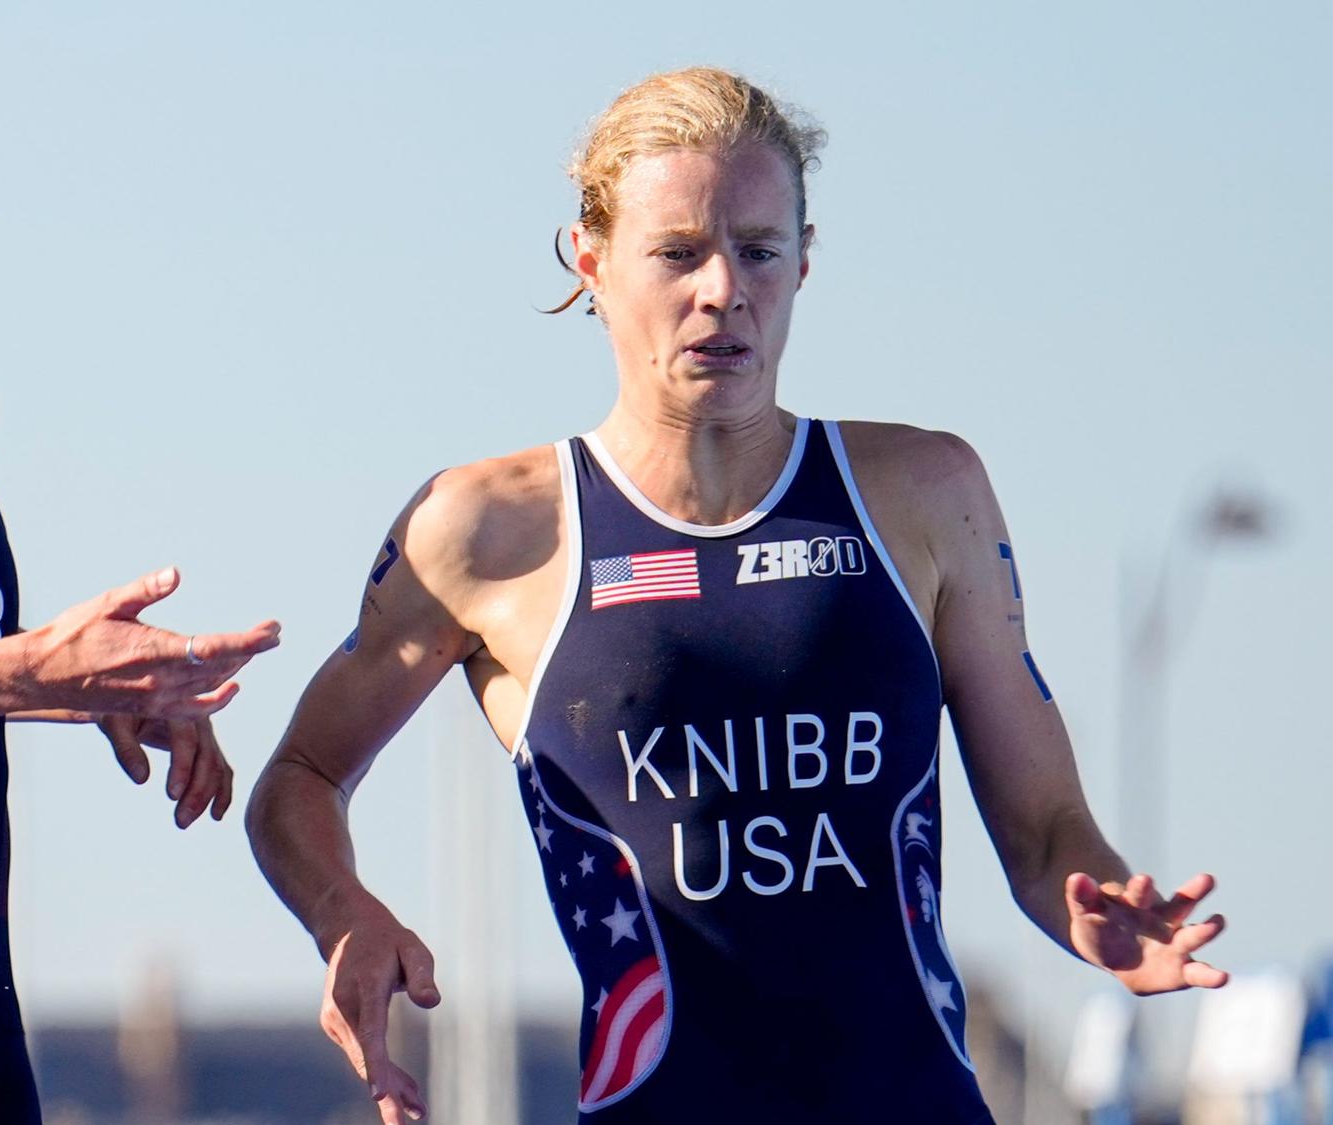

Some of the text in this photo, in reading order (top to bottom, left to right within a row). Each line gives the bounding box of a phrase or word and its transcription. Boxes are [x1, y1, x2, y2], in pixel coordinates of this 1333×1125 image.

[371, 537, 400, 586] 7
[617, 711, 883, 802] KNIBB
[672, 813, 867, 901] USA
